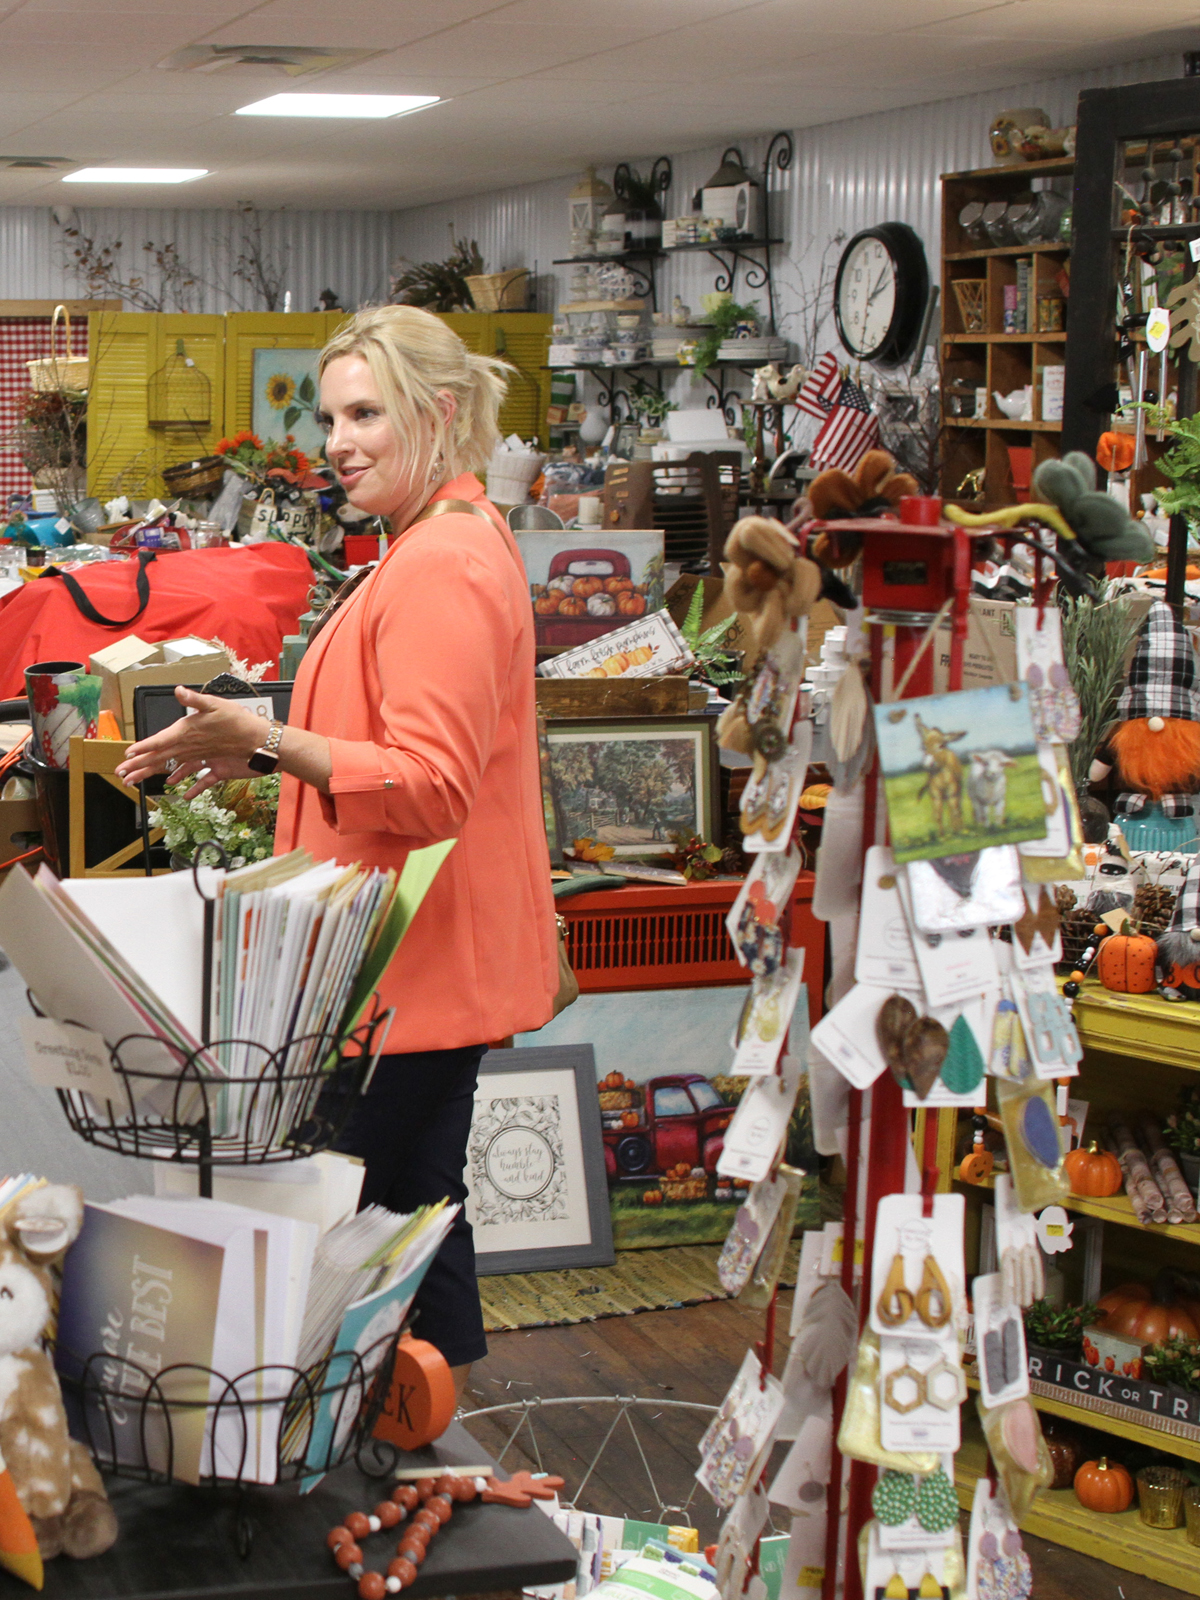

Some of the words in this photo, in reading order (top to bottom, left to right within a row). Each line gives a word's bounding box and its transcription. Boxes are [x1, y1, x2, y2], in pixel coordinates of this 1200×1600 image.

[130, 1254, 174, 1343] BEST
[1028, 1356, 1114, 1398] RICK
[1121, 1388, 1140, 1402] OR
[1149, 1389, 1200, 1424] TR
